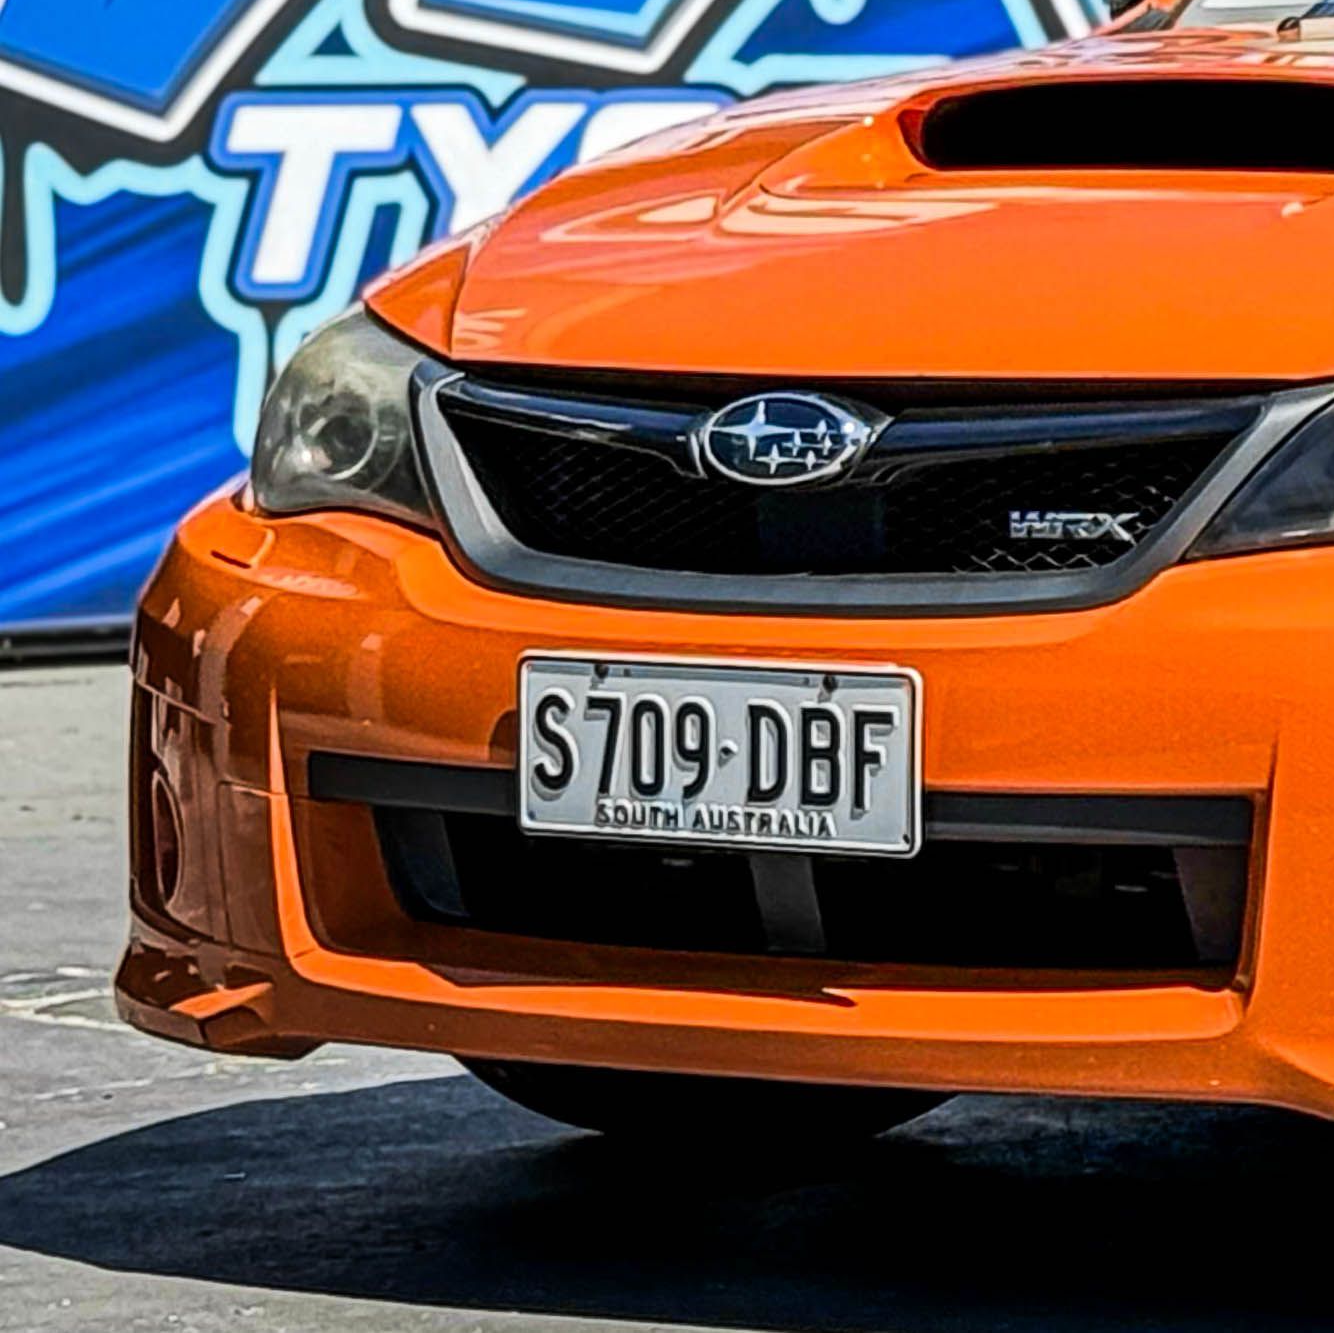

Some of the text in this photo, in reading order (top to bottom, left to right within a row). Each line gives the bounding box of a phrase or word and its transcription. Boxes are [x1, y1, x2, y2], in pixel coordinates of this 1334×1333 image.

[225, 103, 720, 284] TY
[1009, 510, 1140, 547] WRX
[598, 802, 839, 836] SOUTH AUSTRALIA
